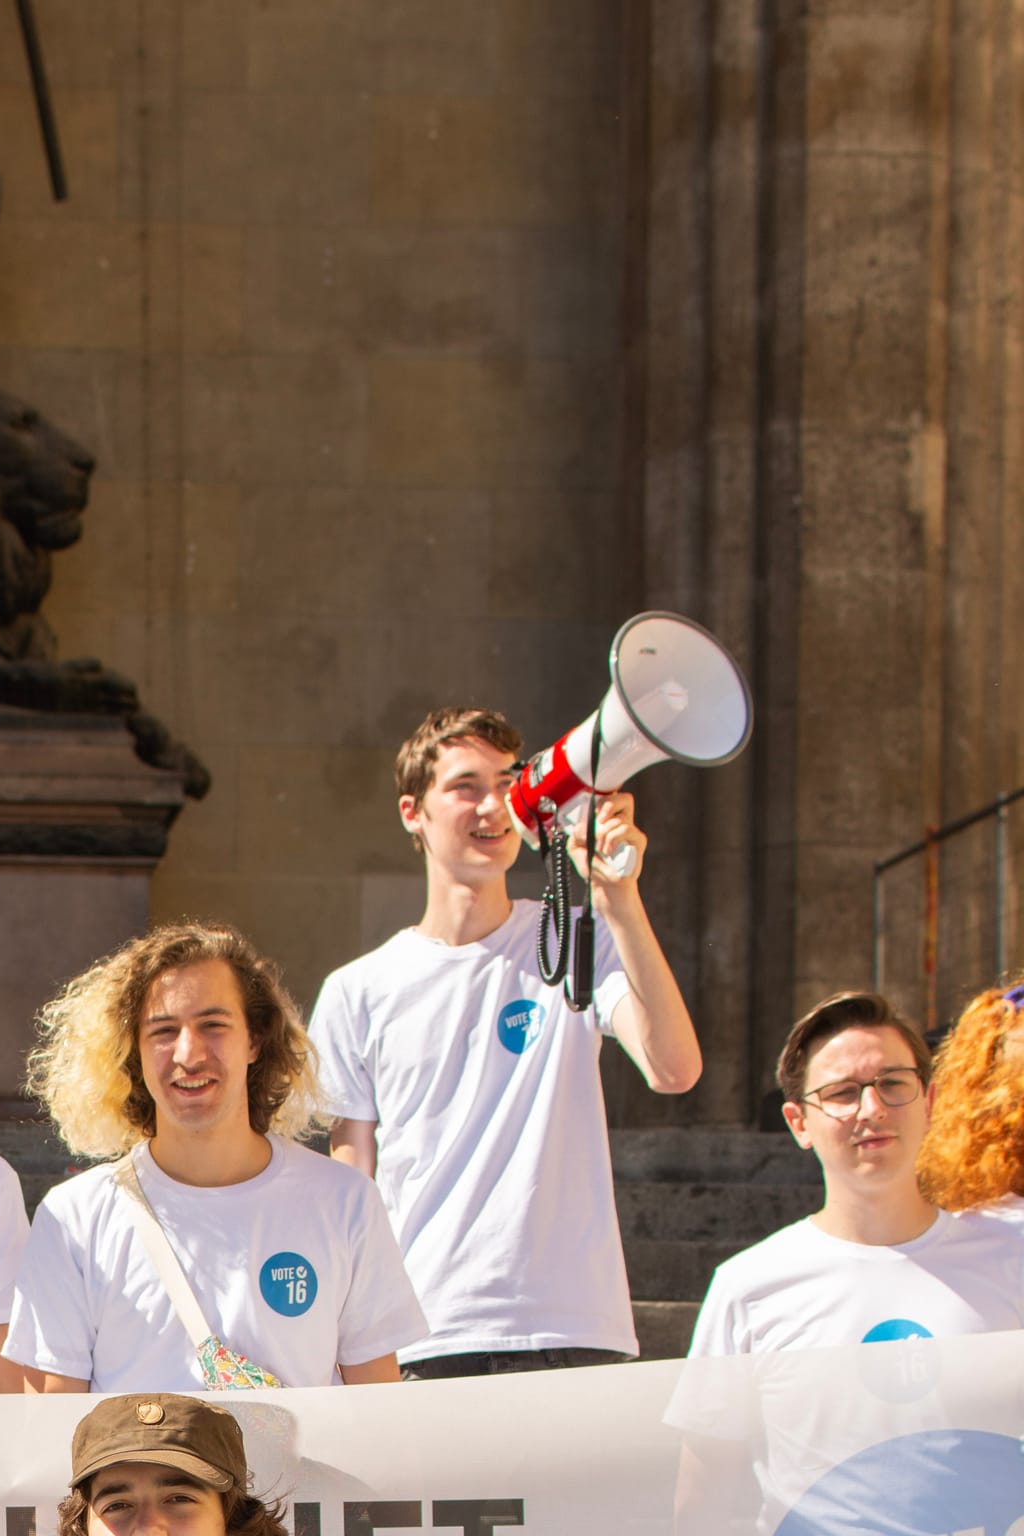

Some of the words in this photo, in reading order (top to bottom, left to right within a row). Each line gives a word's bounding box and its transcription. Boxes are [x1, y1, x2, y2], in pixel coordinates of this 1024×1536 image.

[505, 1012, 528, 1028] VOTE
[271, 1267, 295, 1281] VOTE
[285, 1279, 307, 1305] 16
